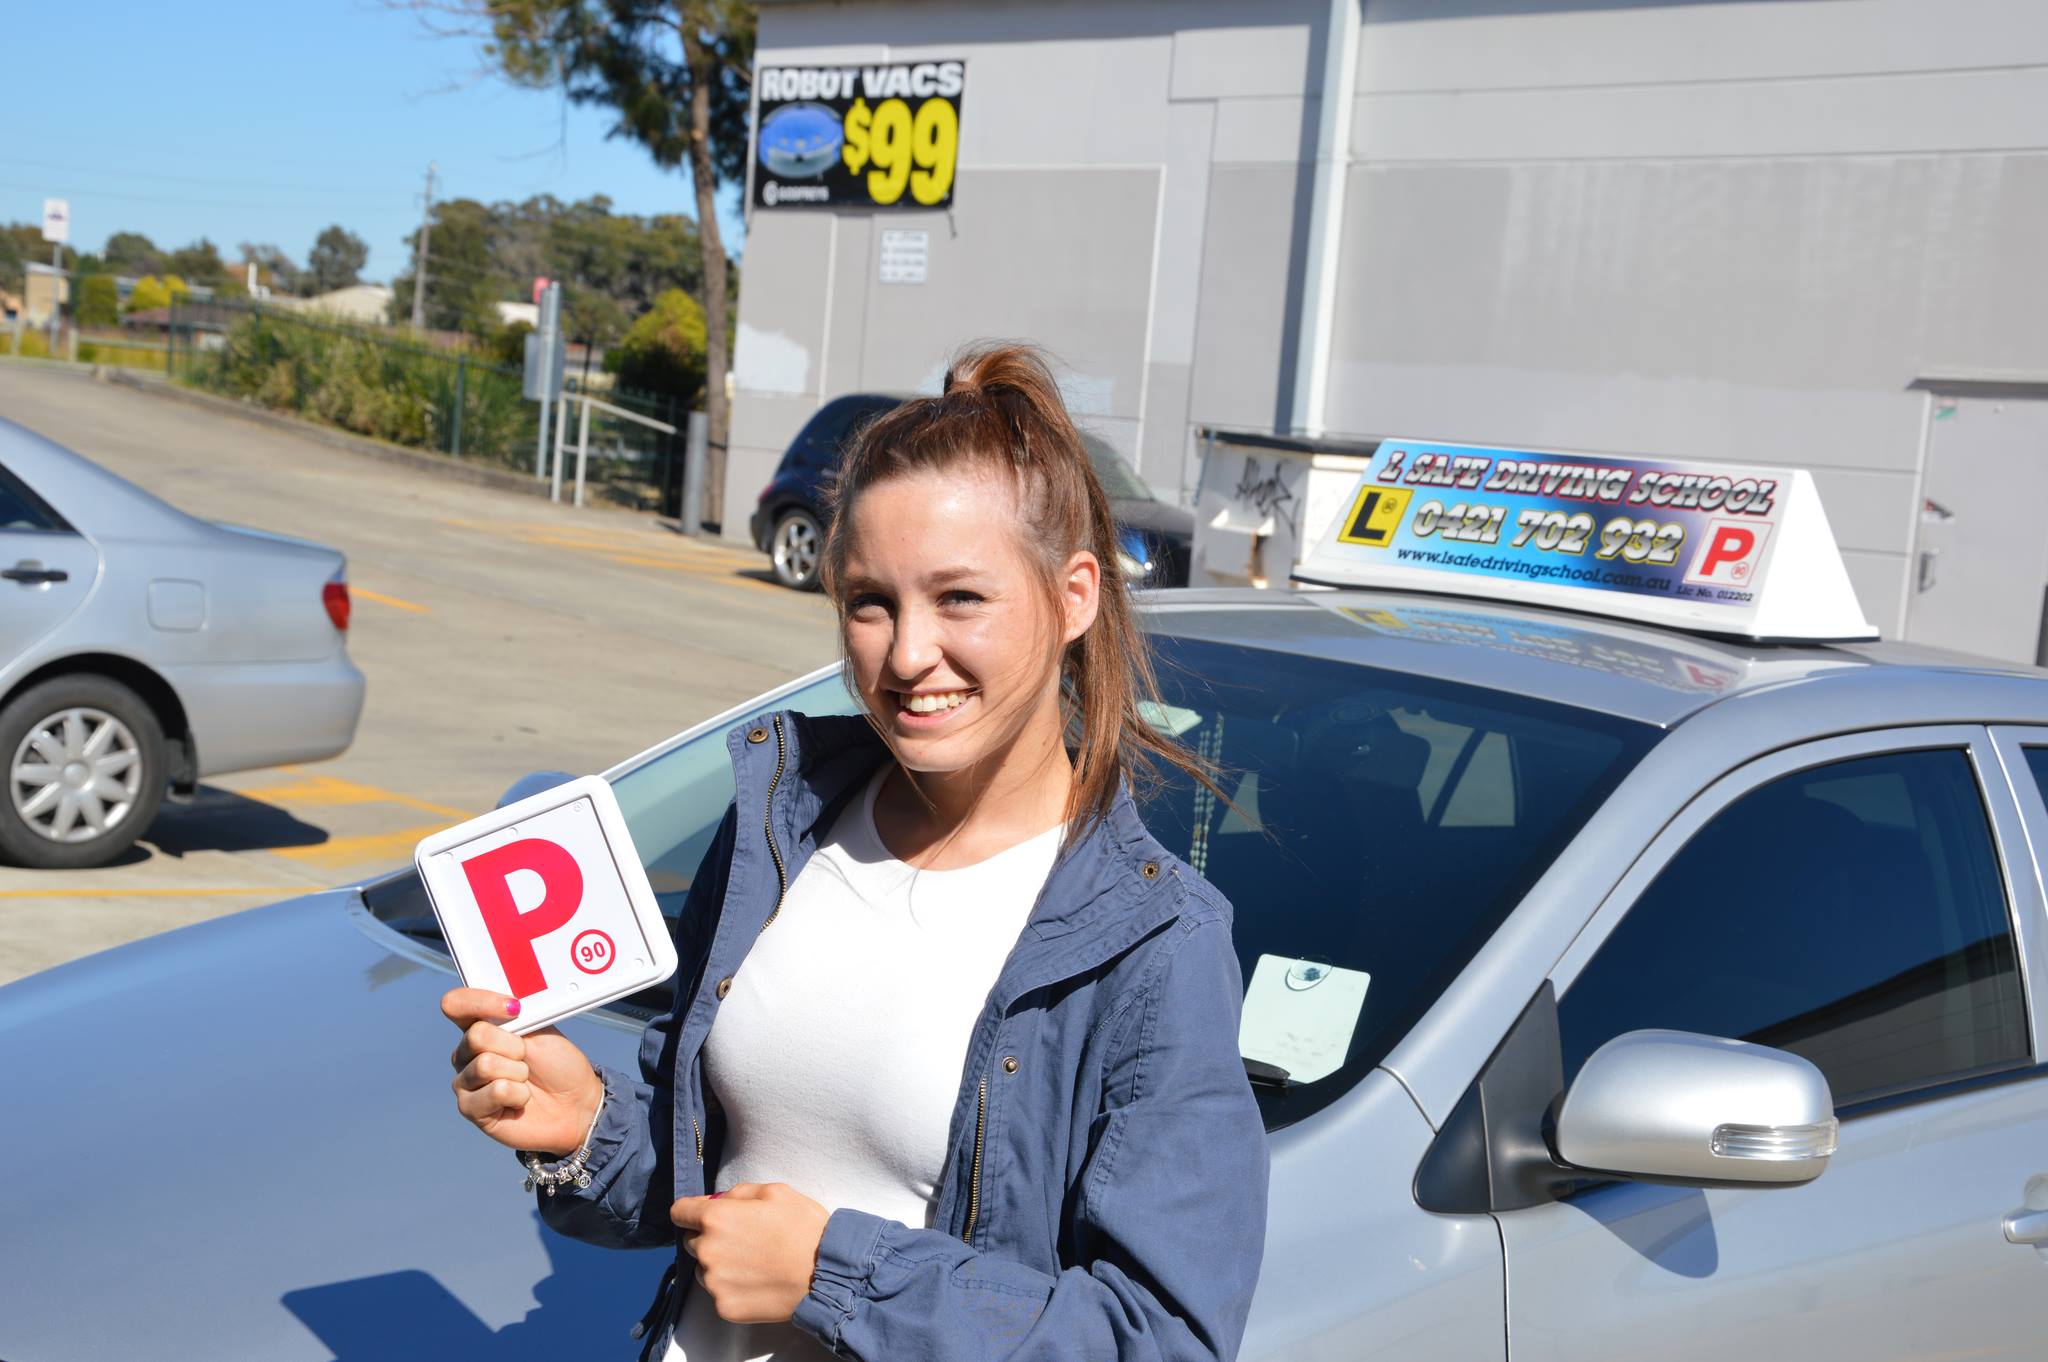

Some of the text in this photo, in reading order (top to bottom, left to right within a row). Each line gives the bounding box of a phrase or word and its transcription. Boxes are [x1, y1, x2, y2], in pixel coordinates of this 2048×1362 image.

[760, 62, 964, 101] ROBOT VACS
[841, 97, 959, 205] $99
[1404, 453, 1491, 489] SAFE
[1484, 459, 1635, 505] DRIVING
[1626, 471, 1778, 516] SCHOOL
[1348, 491, 1387, 541] L
[1411, 500, 1687, 567] 0421 702 932
[1397, 548, 1672, 592] www.lsafedrivingschool.com.au
[1699, 526, 1755, 577] P
[1675, 585, 1694, 595] Lic
[461, 838, 584, 1000] P
[580, 941, 606, 963] 90
